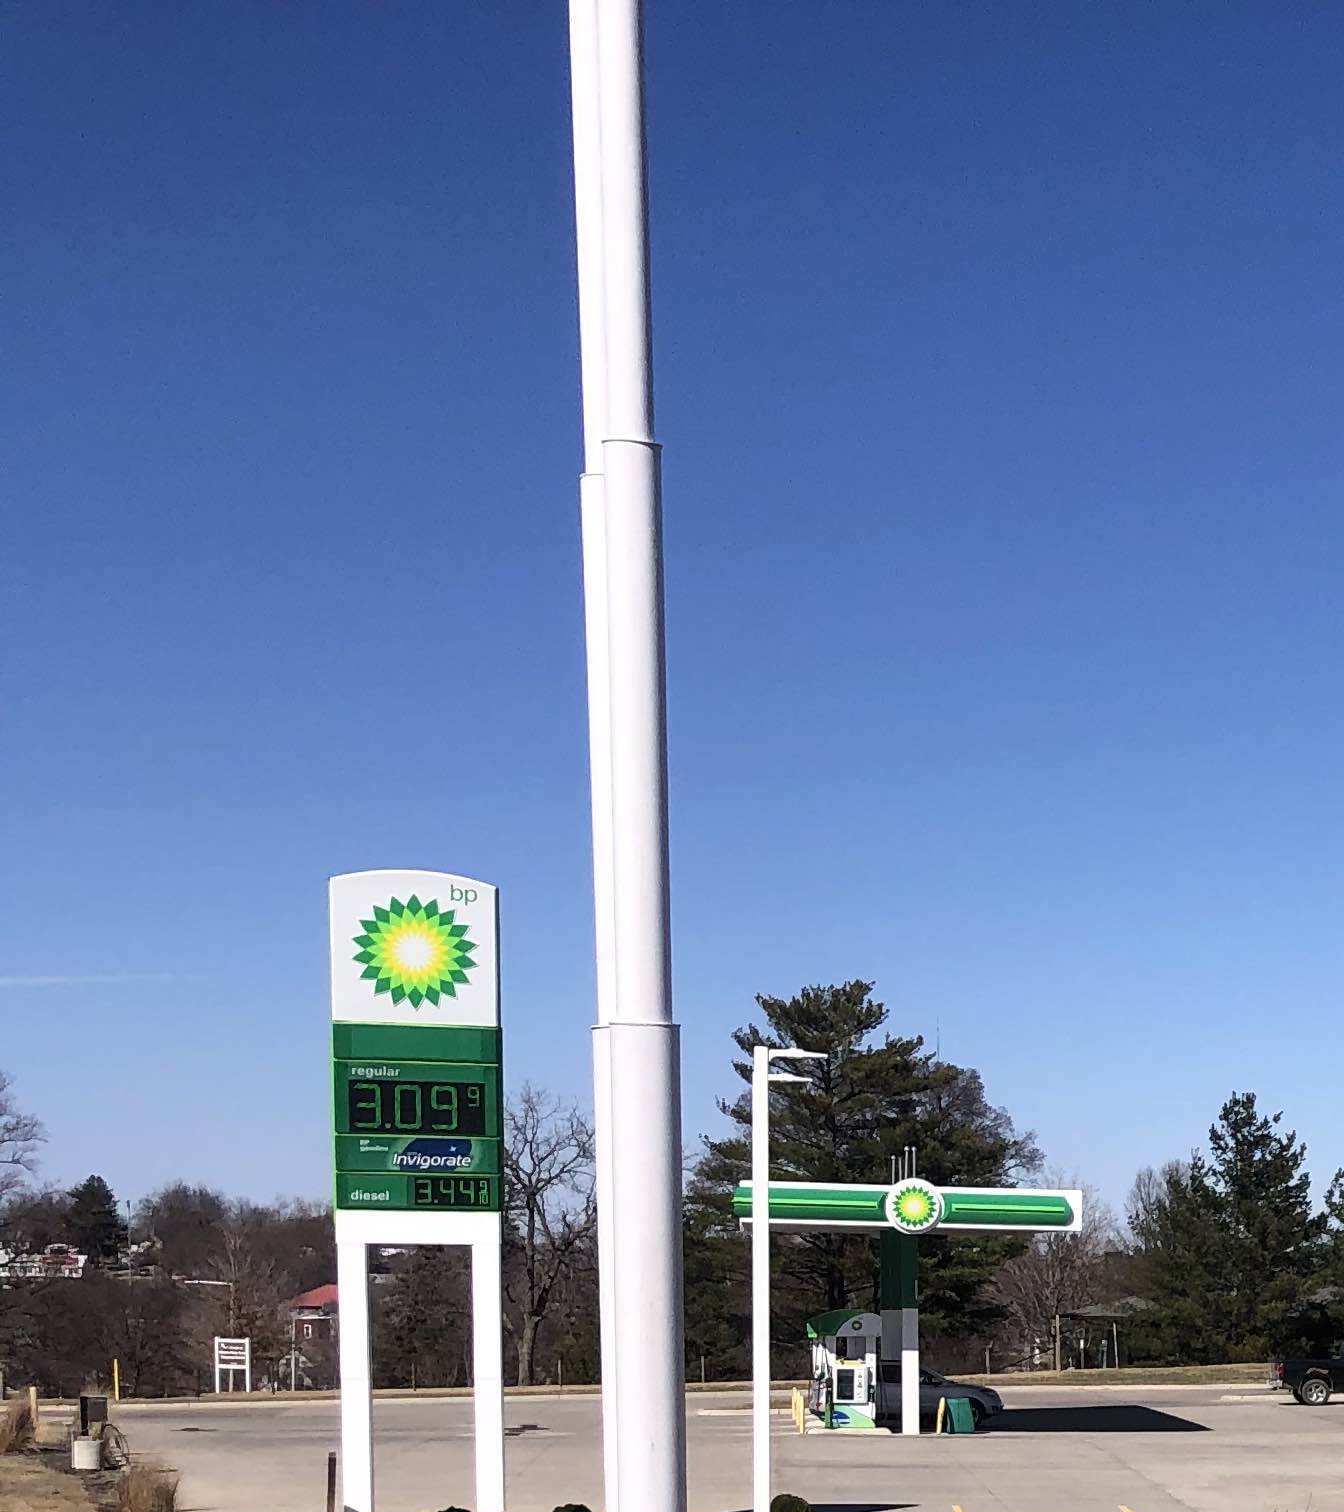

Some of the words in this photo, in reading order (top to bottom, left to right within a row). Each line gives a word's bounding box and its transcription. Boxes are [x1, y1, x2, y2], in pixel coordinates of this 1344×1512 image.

[450, 884, 478, 906] bp
[351, 1065, 400, 1078] regular
[392, 1153, 472, 1169] Invigorate
[350, 1188, 390, 1201] diesel
